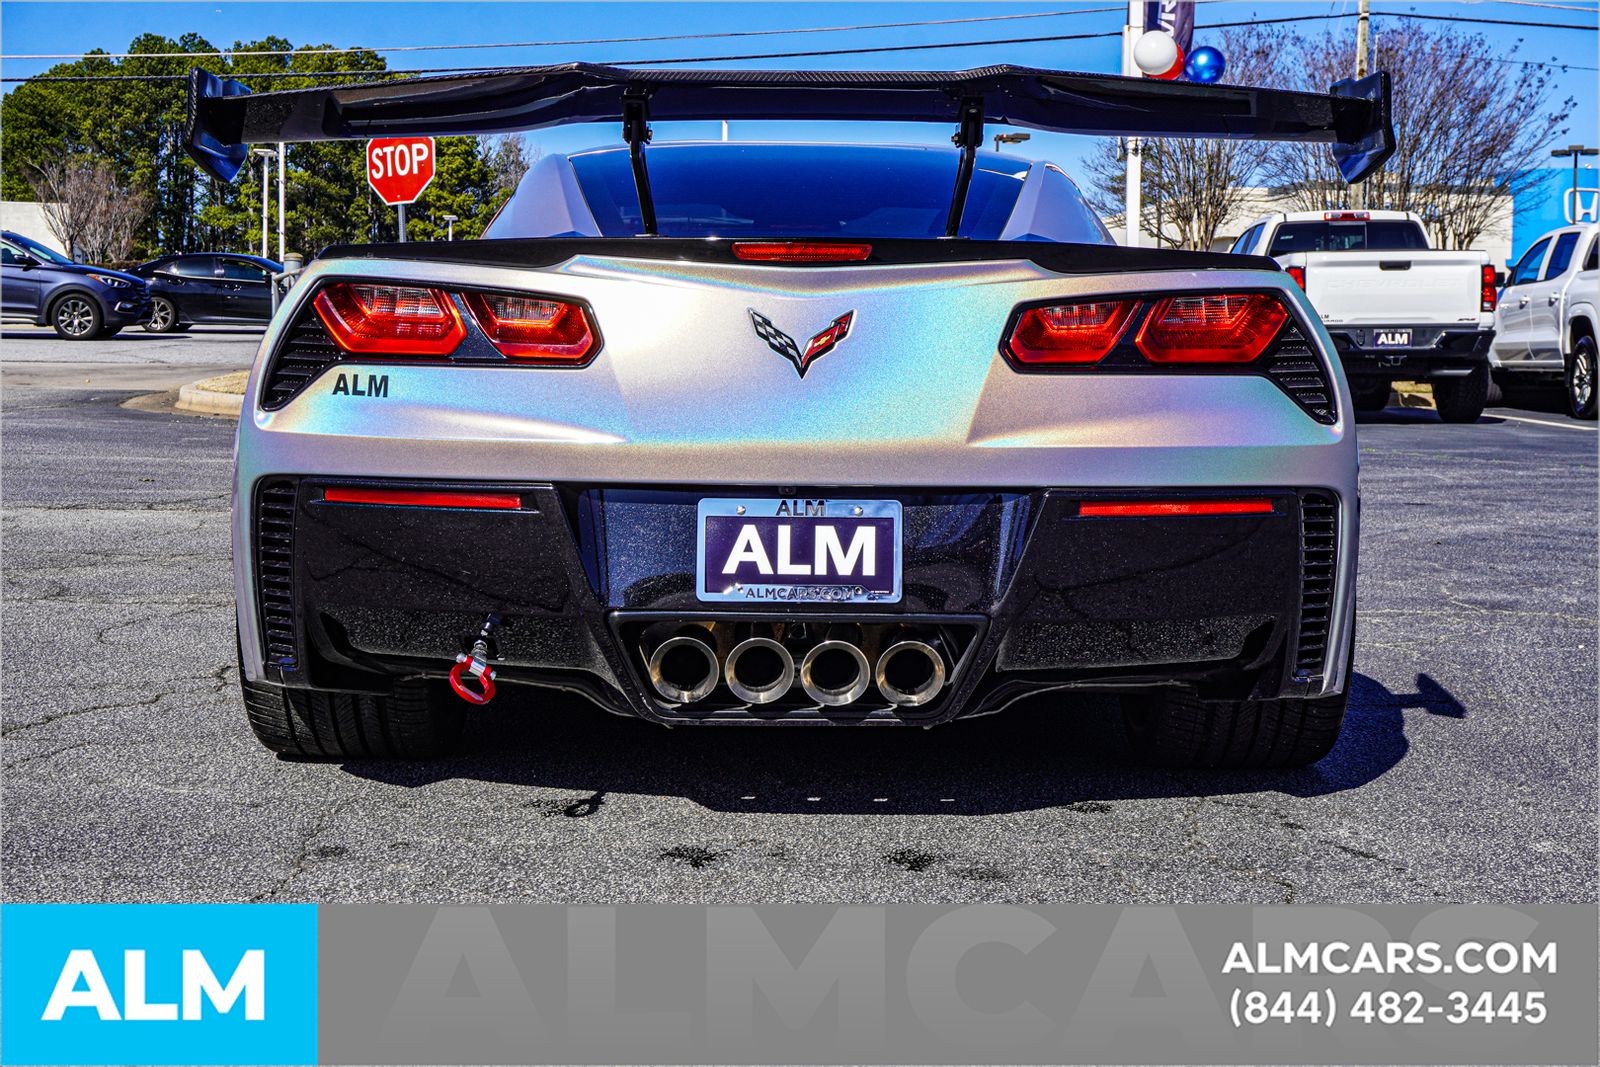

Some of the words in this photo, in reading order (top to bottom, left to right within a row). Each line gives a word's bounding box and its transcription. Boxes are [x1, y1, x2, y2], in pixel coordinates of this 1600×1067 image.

[371, 143, 429, 179] STOP
[1377, 333, 1408, 345] ALM
[332, 373, 389, 398] ALM
[775, 499, 826, 516] ALM
[721, 524, 876, 577] ALM
